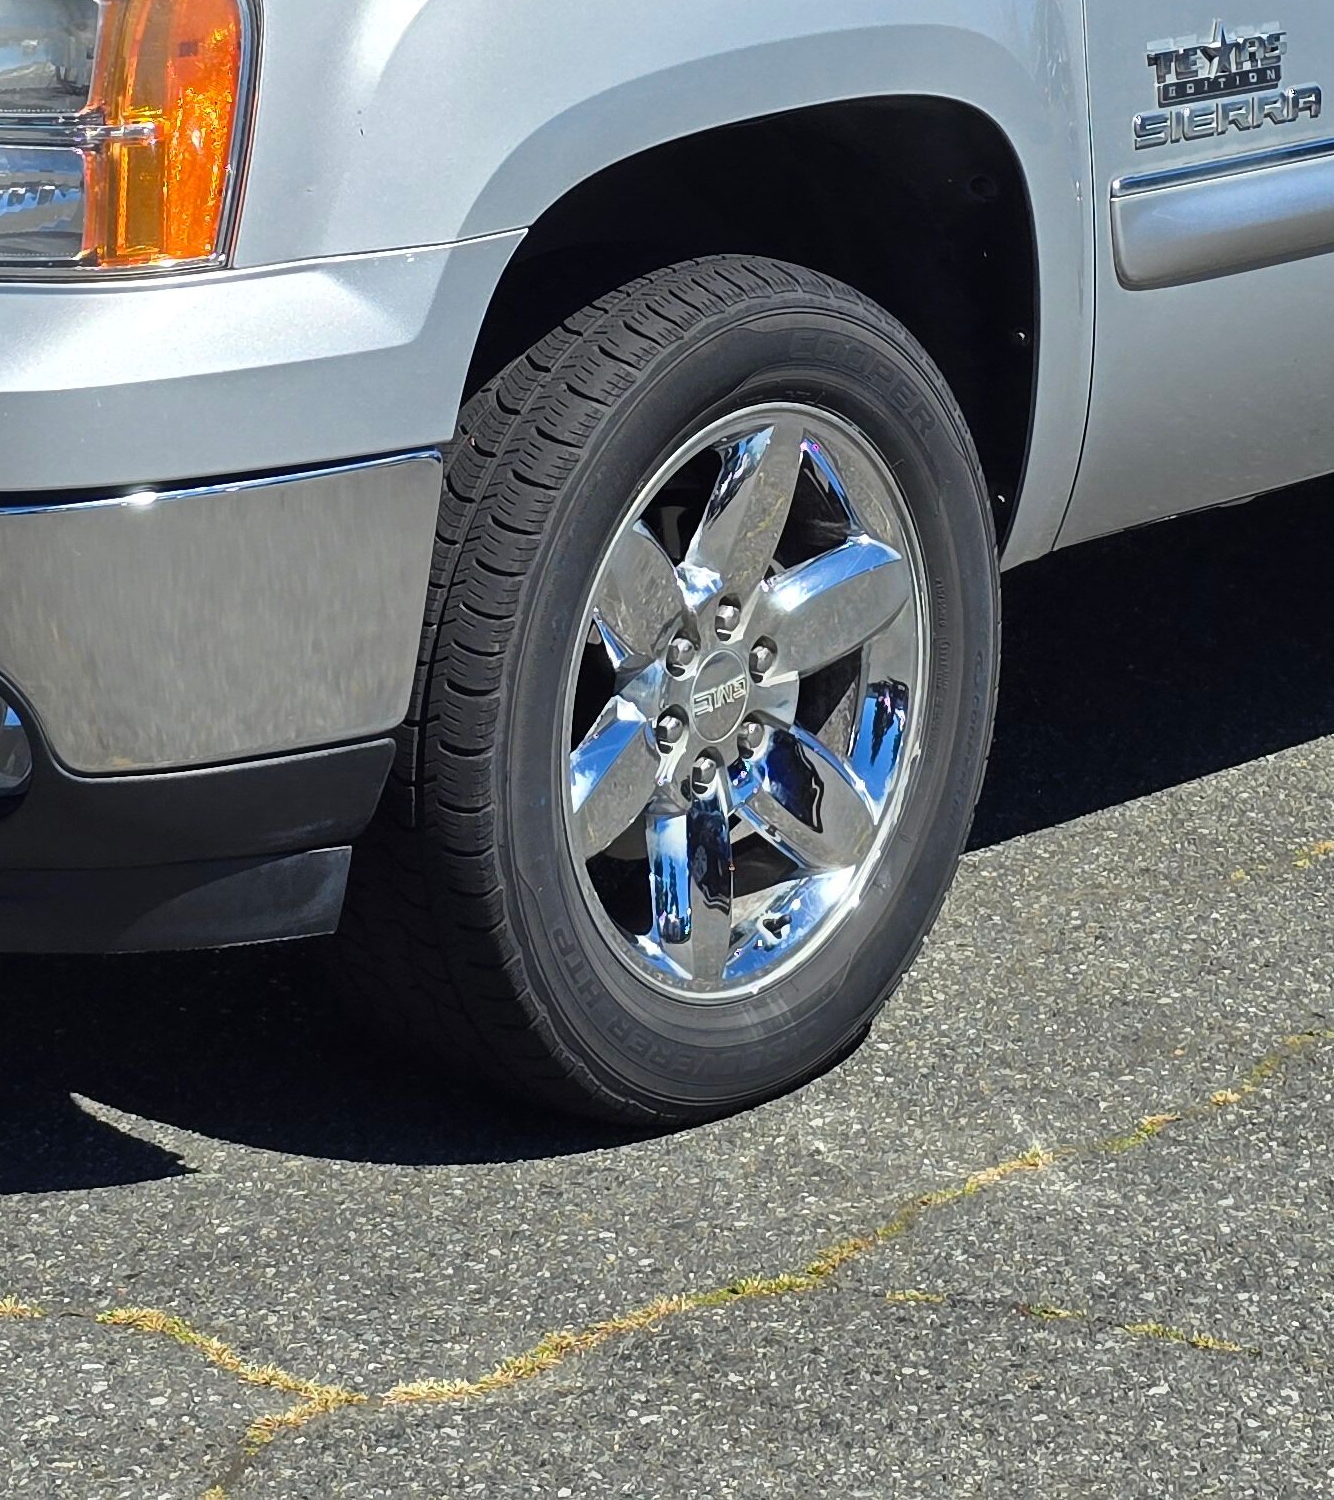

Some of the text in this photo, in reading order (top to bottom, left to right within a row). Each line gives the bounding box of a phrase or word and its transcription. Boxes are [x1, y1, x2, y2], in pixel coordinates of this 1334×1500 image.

[1132, 82, 1322, 151] SIERRA
[1168, 69, 1277, 98] EDITION
[786, 332, 937, 438] COOPER
